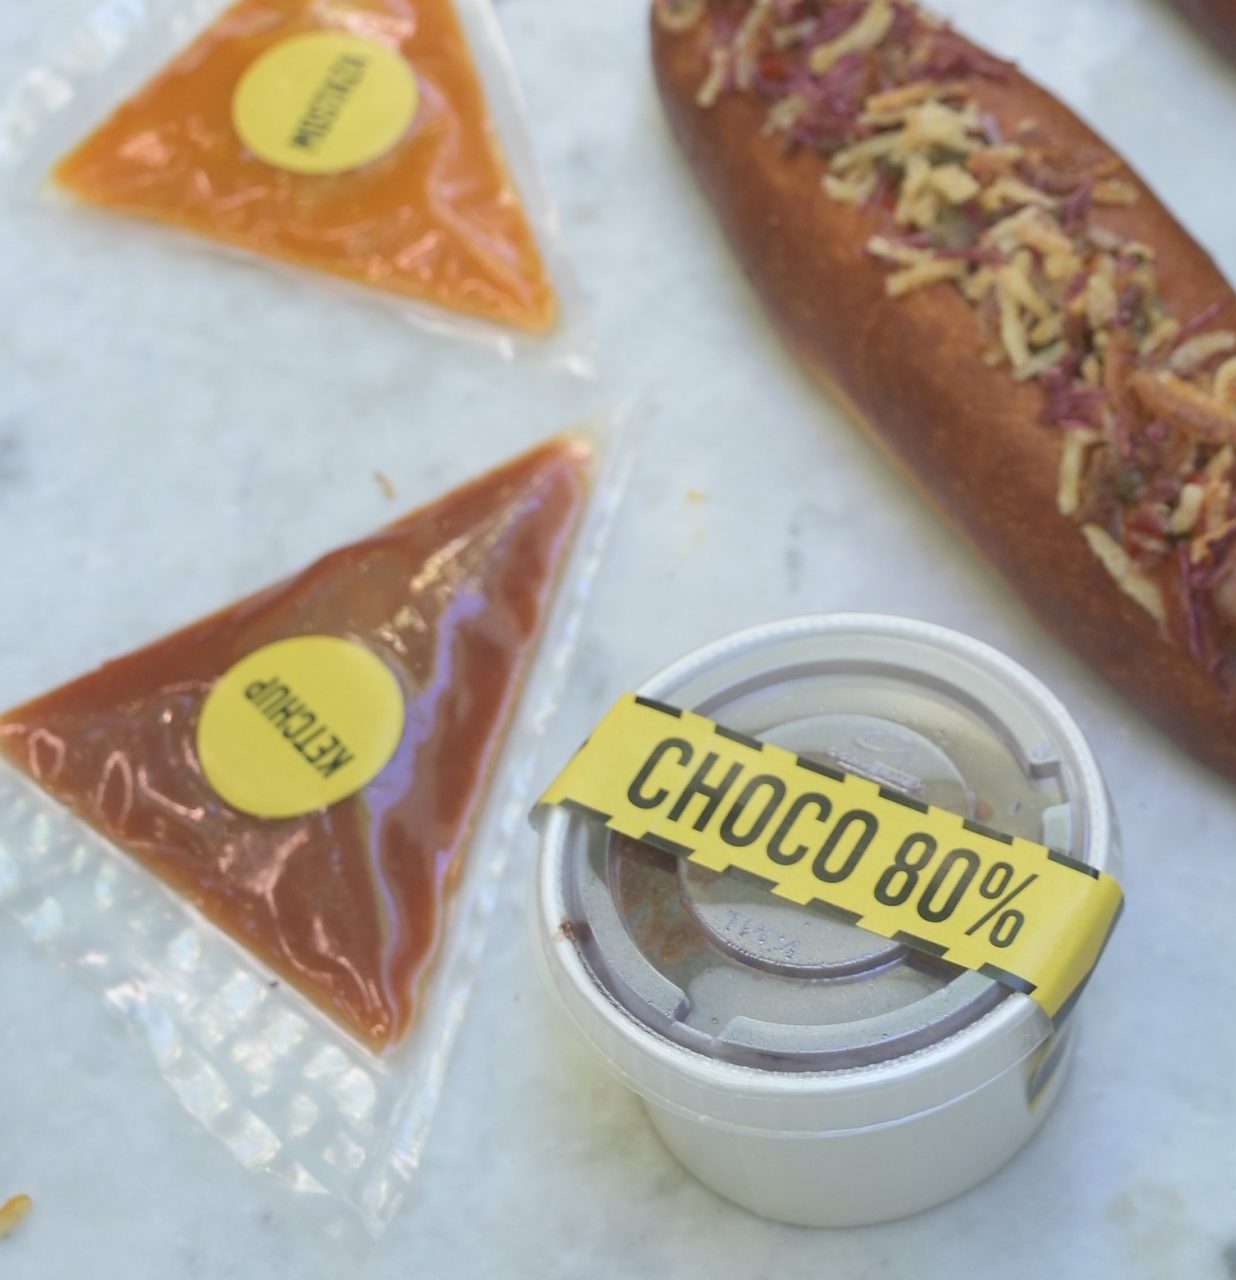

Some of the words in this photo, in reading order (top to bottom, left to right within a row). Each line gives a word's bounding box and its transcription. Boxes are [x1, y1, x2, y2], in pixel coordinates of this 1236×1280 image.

[243, 675, 356, 779] KETCHUP
[626, 737, 879, 883] CHOCO
[873, 832, 1039, 948] 80%
